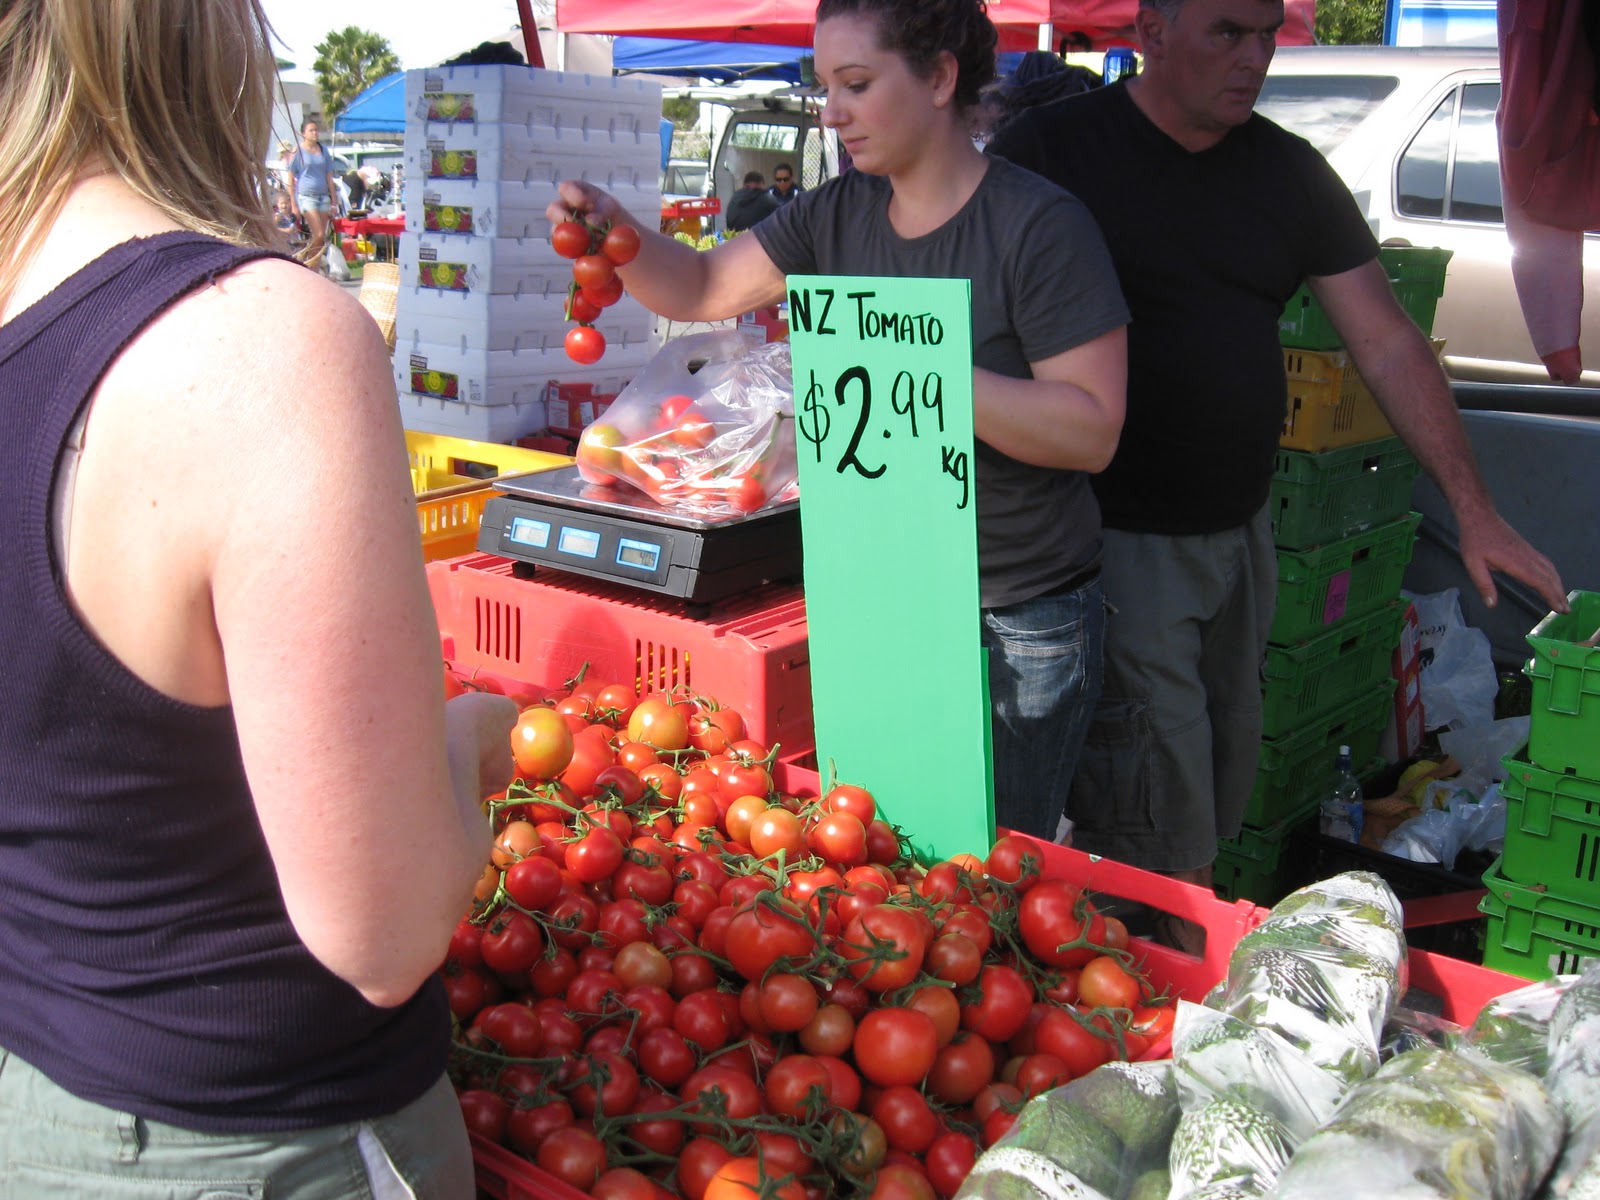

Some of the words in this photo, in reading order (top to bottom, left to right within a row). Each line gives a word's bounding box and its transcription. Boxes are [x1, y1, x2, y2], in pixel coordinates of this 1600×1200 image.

[789, 288, 837, 336] NZ
[846, 291, 944, 346] TOMATO
[799, 365, 944, 479] $2.99
